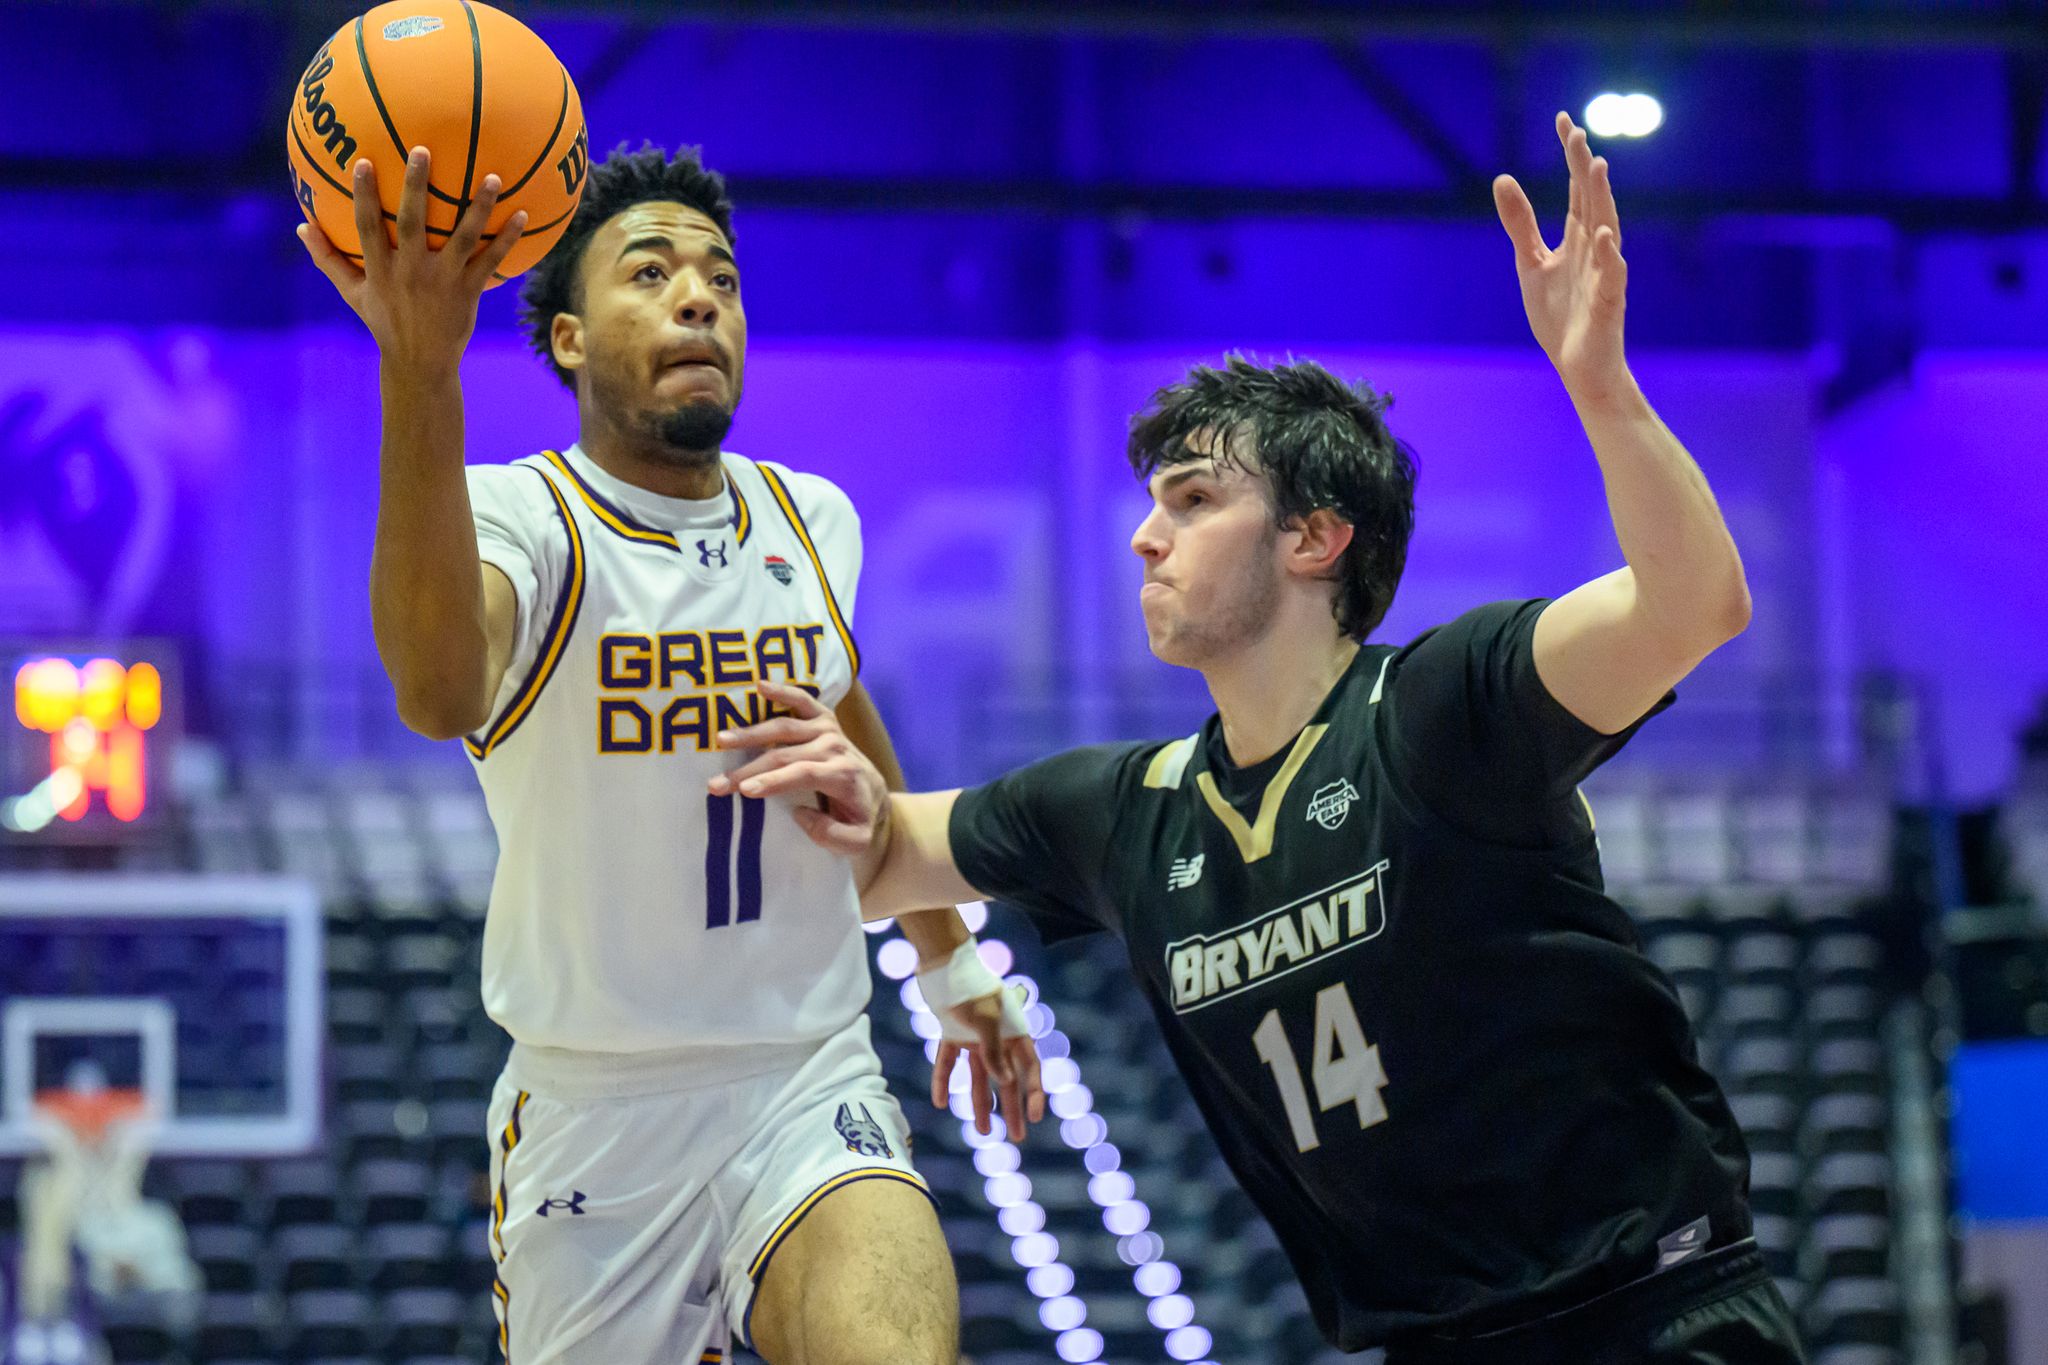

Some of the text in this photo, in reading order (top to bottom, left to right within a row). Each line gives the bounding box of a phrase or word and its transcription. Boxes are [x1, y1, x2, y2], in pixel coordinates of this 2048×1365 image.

[597, 624, 824, 691] GREAT
[1308, 787, 1355, 816] AMERICA
[1321, 802, 1346, 820] EAST
[705, 792, 766, 930] 11
[1170, 875, 1376, 1006] BRYANT
[1252, 981, 1390, 1154] 14
